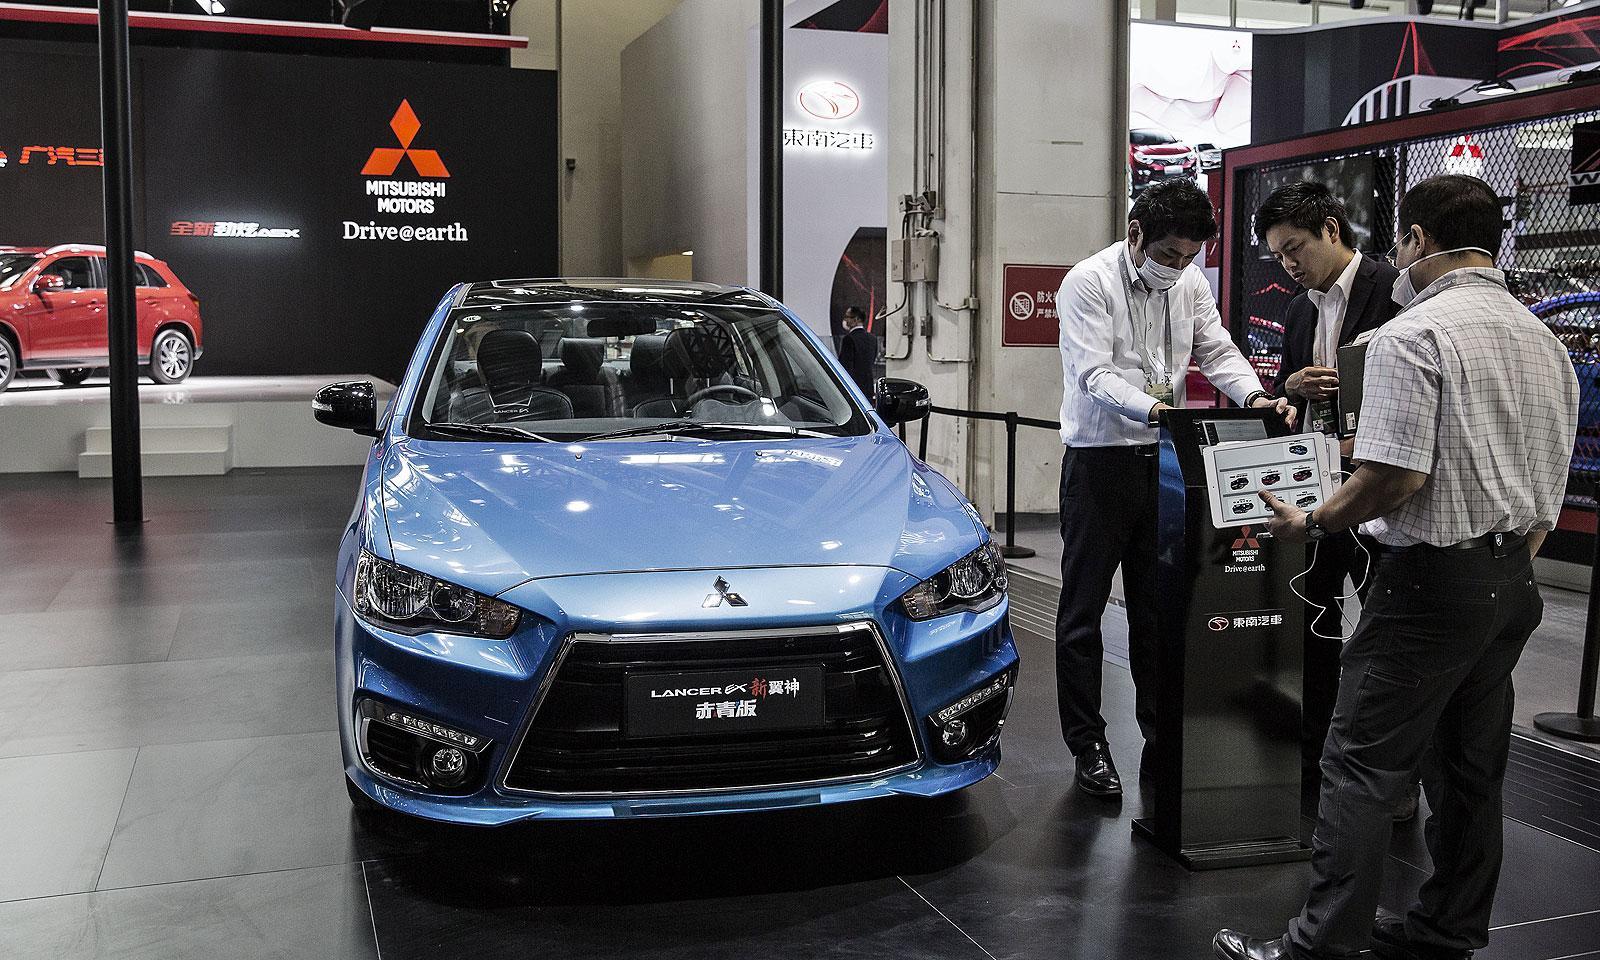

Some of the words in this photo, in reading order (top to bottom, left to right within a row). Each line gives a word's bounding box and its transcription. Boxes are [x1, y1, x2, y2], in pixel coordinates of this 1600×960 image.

[19, 145, 104, 166] 广汽三
[365, 180, 446, 198] MITSUBISHI
[377, 197, 435, 214] MOTORS
[342, 220, 469, 242] Drive@earth
[1232, 549, 1259, 557] MITSUBISHI
[1224, 564, 1266, 573] Drive@earth
[650, 687, 723, 698] LANCER
[750, 677, 800, 700] 新翼神
[695, 699, 758, 720] 赤青版
